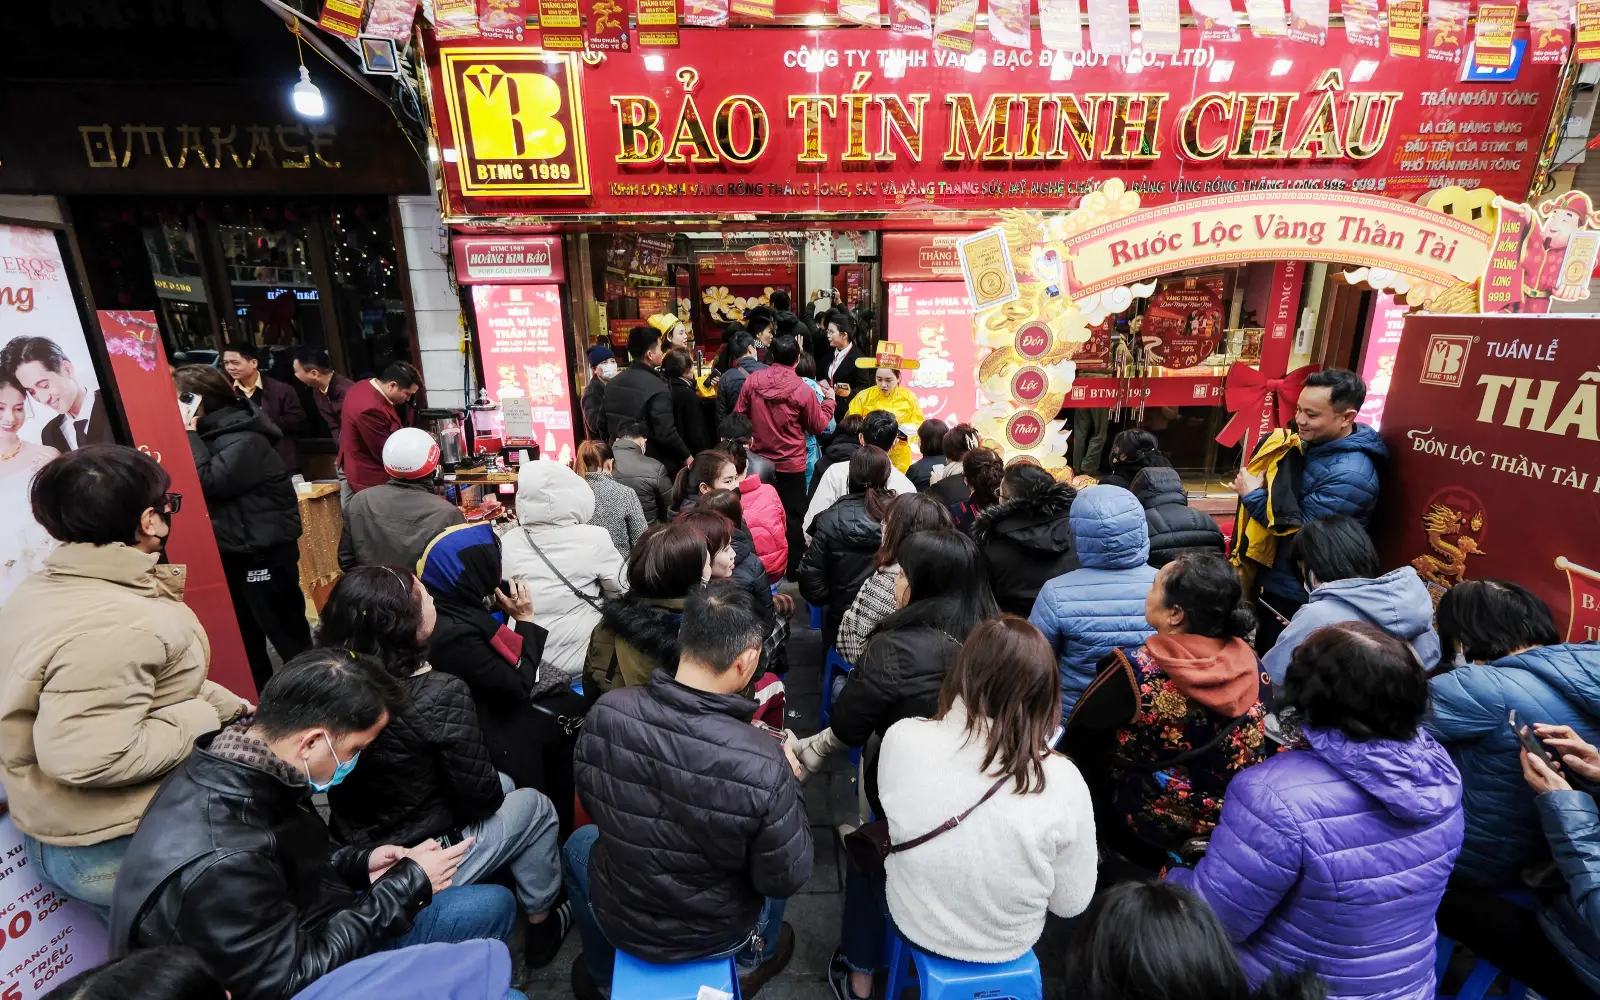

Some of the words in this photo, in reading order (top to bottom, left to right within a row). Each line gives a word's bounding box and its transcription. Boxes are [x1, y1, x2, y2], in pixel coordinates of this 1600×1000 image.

[783, 45, 839, 68] CÔNG
[844, 50, 871, 67] TY
[876, 49, 928, 67] TNHH
[992, 49, 1034, 71] BẠC
[1170, 46, 1215, 68] LTD)
[1458, 90, 1498, 106] NHÂN
[1501, 90, 1539, 106] TÔNG
[610, 66, 770, 164] BẢO
[787, 71, 931, 163] TÍN
[943, 92, 1169, 163] MINH
[1178, 68, 1404, 161] CHÂU
[1459, 121, 1491, 134] HÀNG
[477, 164, 524, 181] BTMC
[529, 163, 571, 180] 1989
[641, 182, 687, 197] DOANH
[727, 179, 764, 196] RỒNG
[855, 181, 877, 196] SJC
[1108, 230, 1183, 267] Rước
[1192, 220, 1243, 249] Lộc
[1253, 213, 1327, 246] Vàng
[1337, 215, 1405, 250] Thần
[1415, 228, 1460, 264] Tài
[470, 250, 504, 265] HOÀNG
[506, 253, 525, 264] KIM
[526, 250, 547, 264] BẢO
[920, 250, 952, 260] THĂNG
[1493, 257, 1517, 270] THĂNG
[3, 256, 57, 273] EROS
[1492, 276, 1512, 287] LONG
[1277, 281, 1293, 319] BTMC
[1488, 292, 1511, 302] 999.9
[517, 316, 552, 327] VÀNG
[529, 327, 549, 338] TÀI
[1022, 335, 1044, 347] Đón
[1486, 338, 1533, 360] TUẦN
[1535, 338, 1559, 362] LỄ
[1019, 379, 1038, 392] Lộc
[1409, 435, 1448, 457] ĐÓN
[1450, 444, 1485, 466] LỘC
[1490, 453, 1546, 480] THẦN
[1551, 465, 1590, 490] TÀI
[7, 944, 49, 979] TRANG
[29, 943, 69, 979] TRIỆU
[33, 953, 74, 991] ĐỒNG
